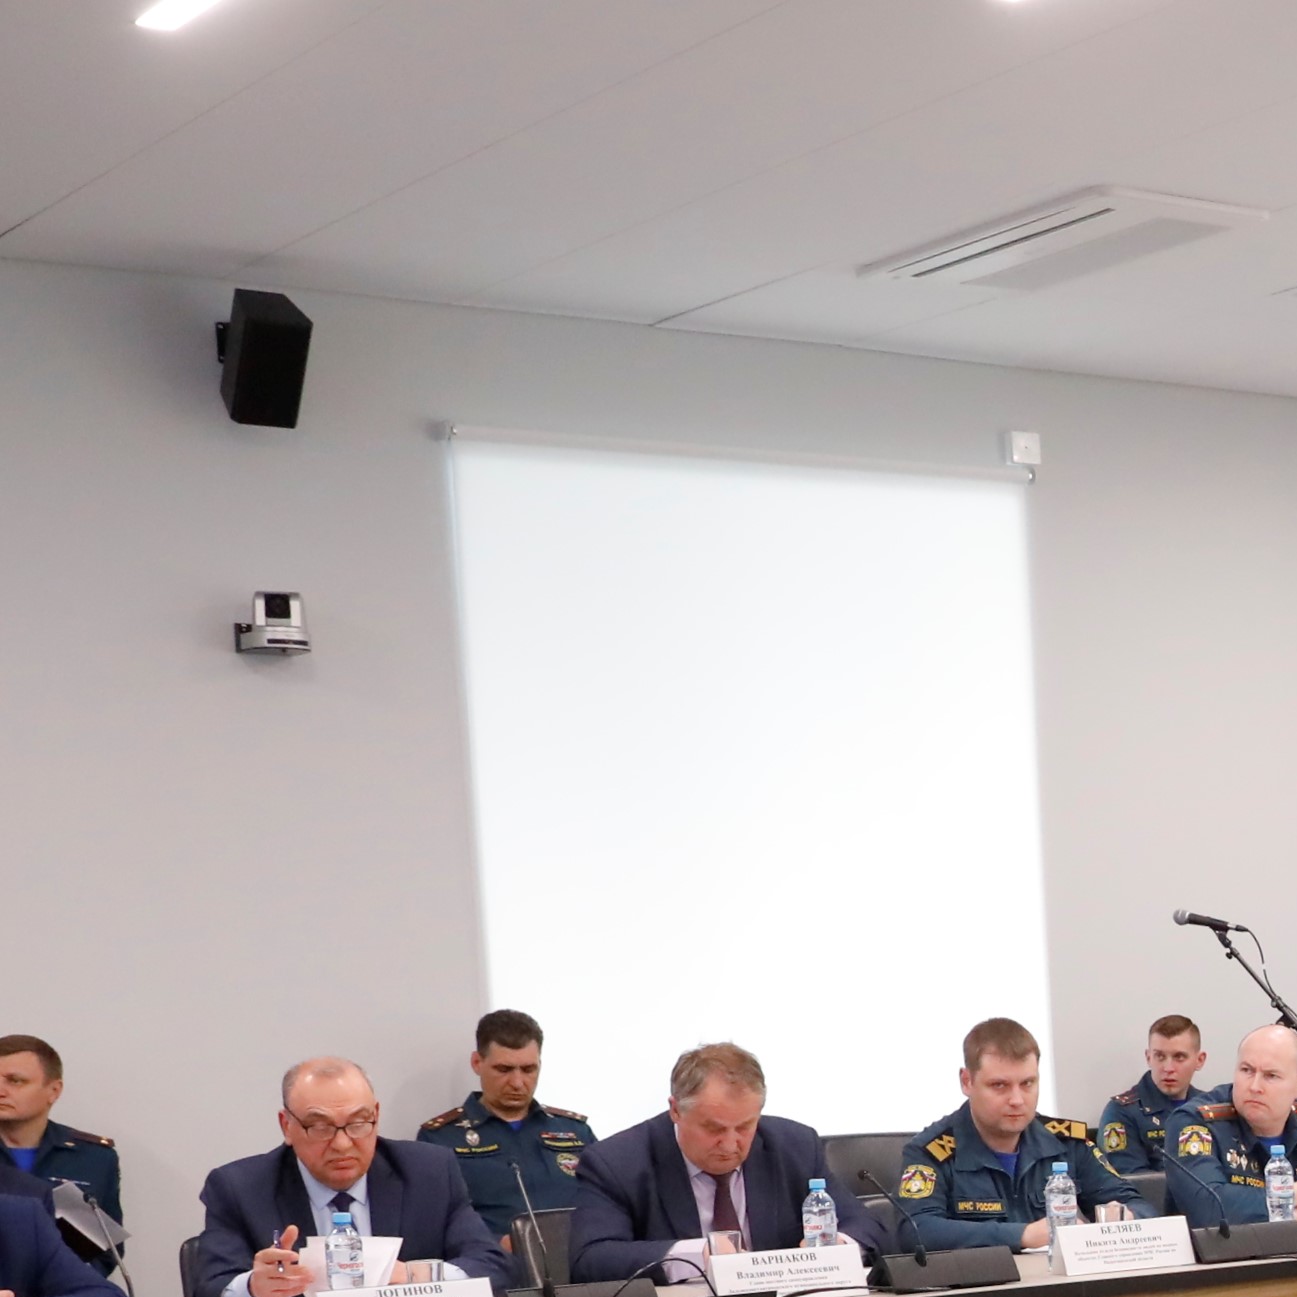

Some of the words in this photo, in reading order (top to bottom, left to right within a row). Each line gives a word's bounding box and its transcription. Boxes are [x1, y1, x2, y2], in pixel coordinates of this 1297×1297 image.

[1100, 1223, 1142, 1235] БЕЛЯЕВ
[1085, 1238, 1117, 1248] Никита
[751, 1252, 817, 1266] ВАРНАКОВ
[736, 1268, 784, 1280] Владимир
[786, 1265, 840, 1276] Алексеевич
